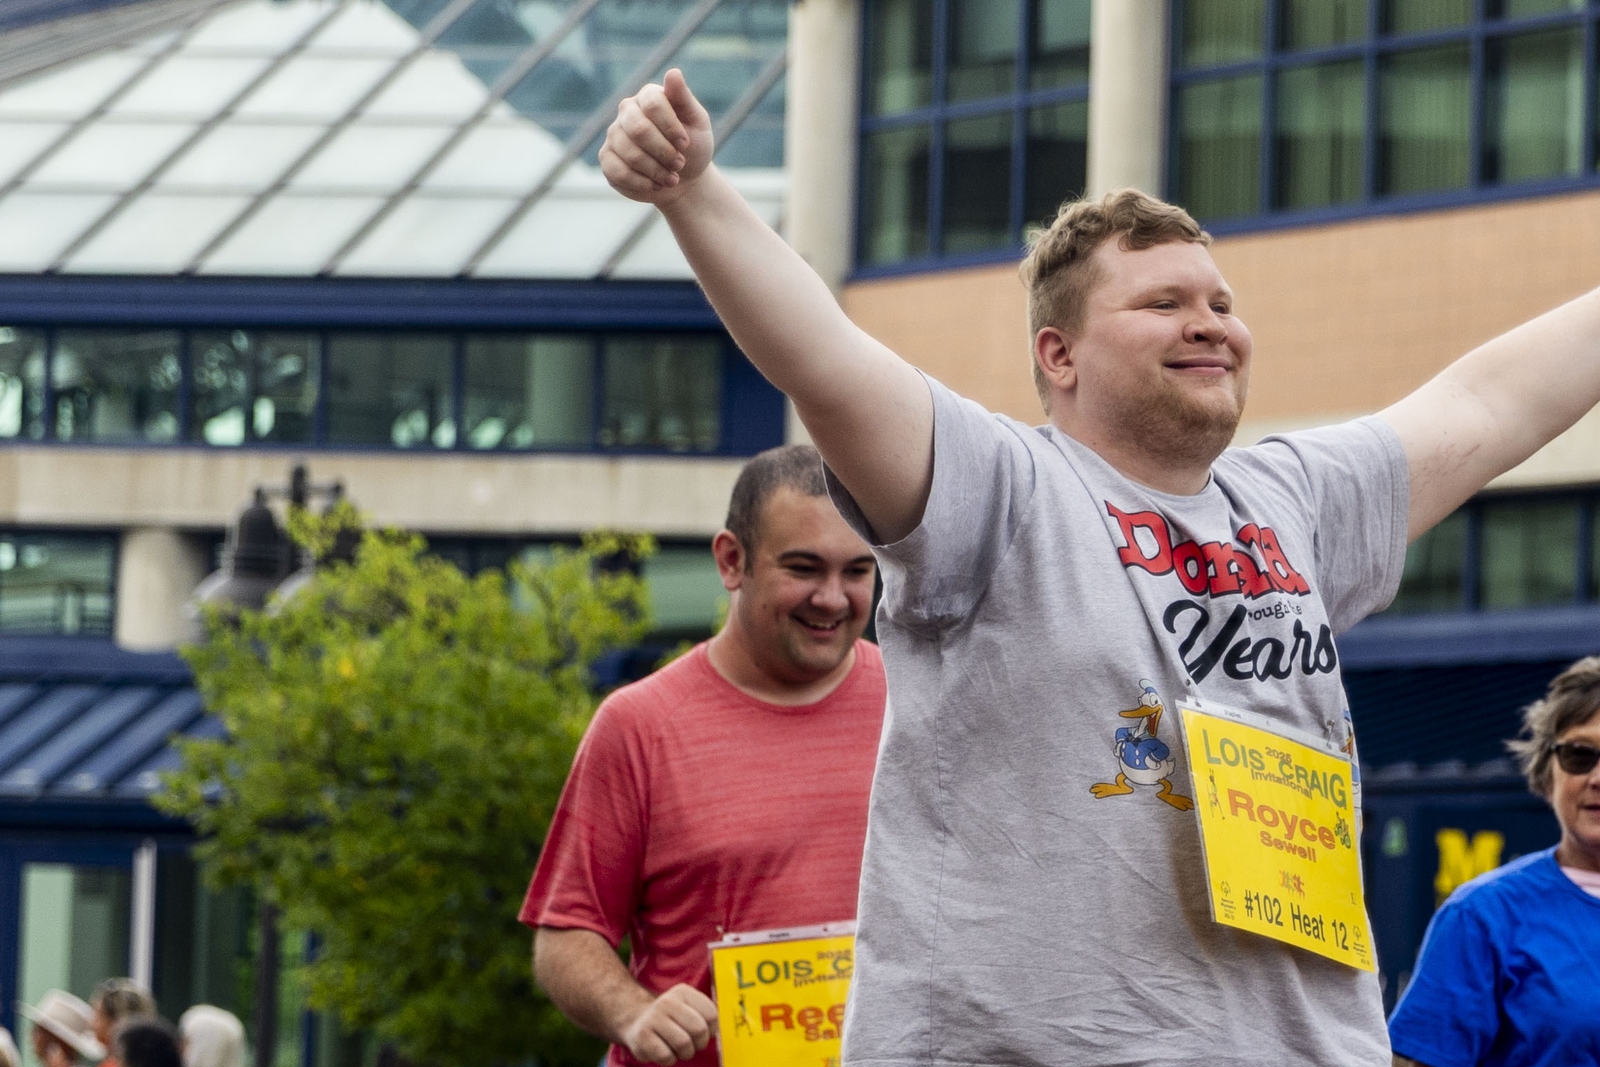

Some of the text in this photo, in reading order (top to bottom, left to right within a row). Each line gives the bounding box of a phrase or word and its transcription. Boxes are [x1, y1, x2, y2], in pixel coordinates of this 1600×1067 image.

[1163, 599, 1337, 685] Years
[1202, 728, 1348, 810] LOIS CRAIG
[1265, 747, 1293, 764] 2025
[1250, 769, 1313, 801] Invitational
[1227, 788, 1337, 851] Royce
[1260, 830, 1317, 863] Sewell
[1244, 889, 1284, 927] #102
[1291, 902, 1326, 942] Heat
[1332, 918, 1350, 952] 12
[736, 960, 813, 989] LOIS
